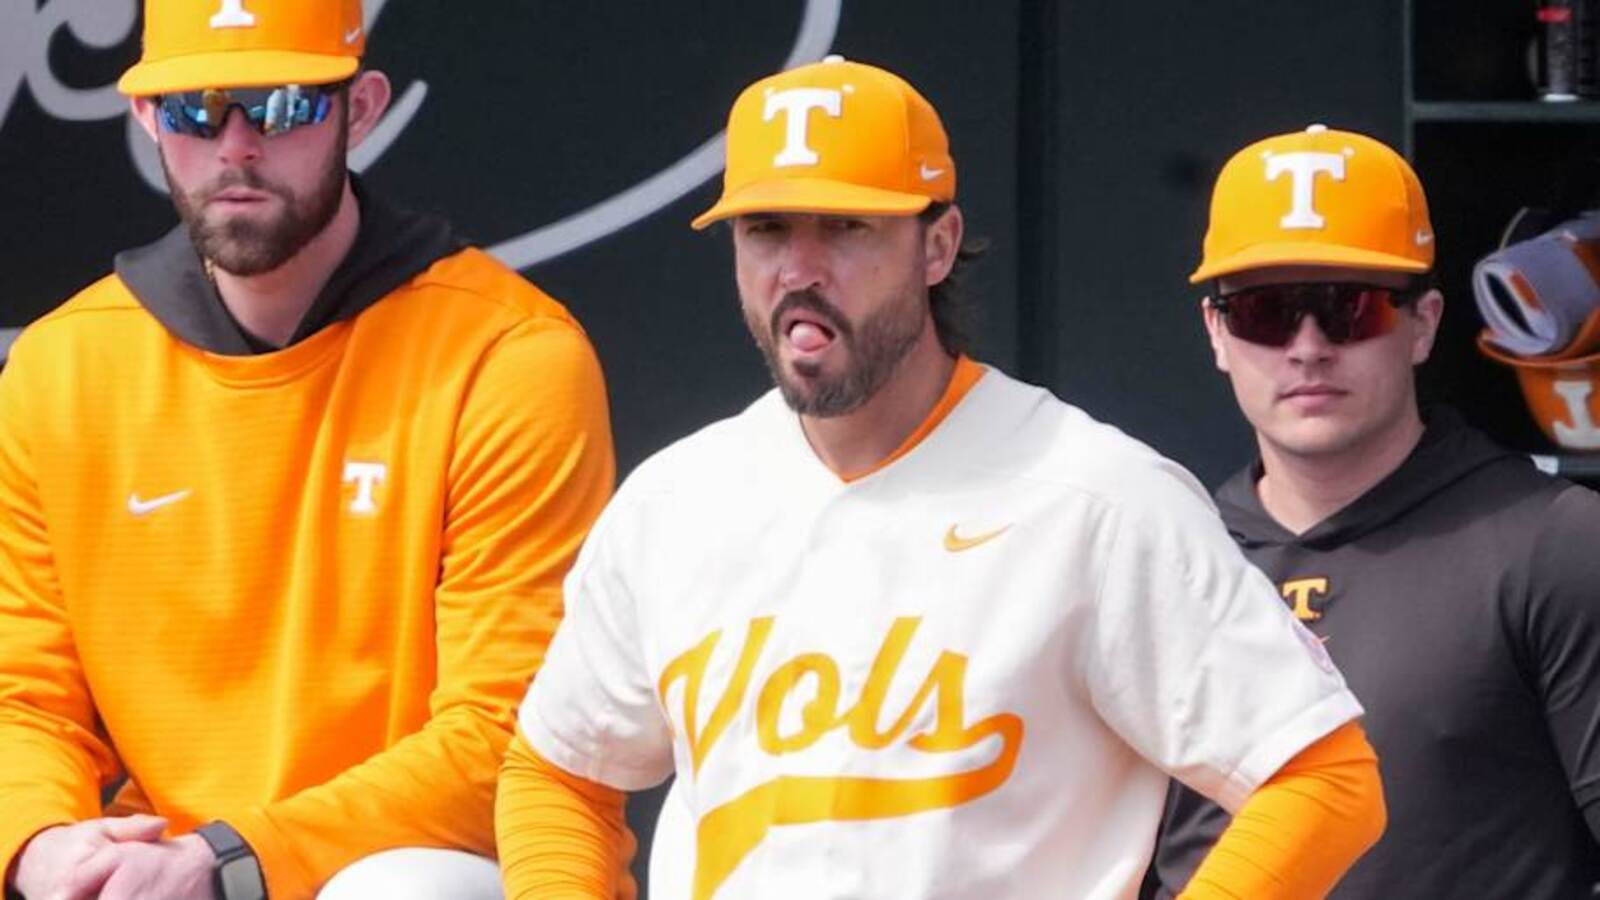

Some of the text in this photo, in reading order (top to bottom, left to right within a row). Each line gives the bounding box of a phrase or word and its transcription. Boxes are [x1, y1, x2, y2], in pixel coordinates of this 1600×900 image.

[762, 86, 844, 168] T
[1264, 150, 1346, 230] T
[343, 462, 386, 513] T
[1282, 577, 1327, 620] T
[658, 615, 1025, 784] Vols
